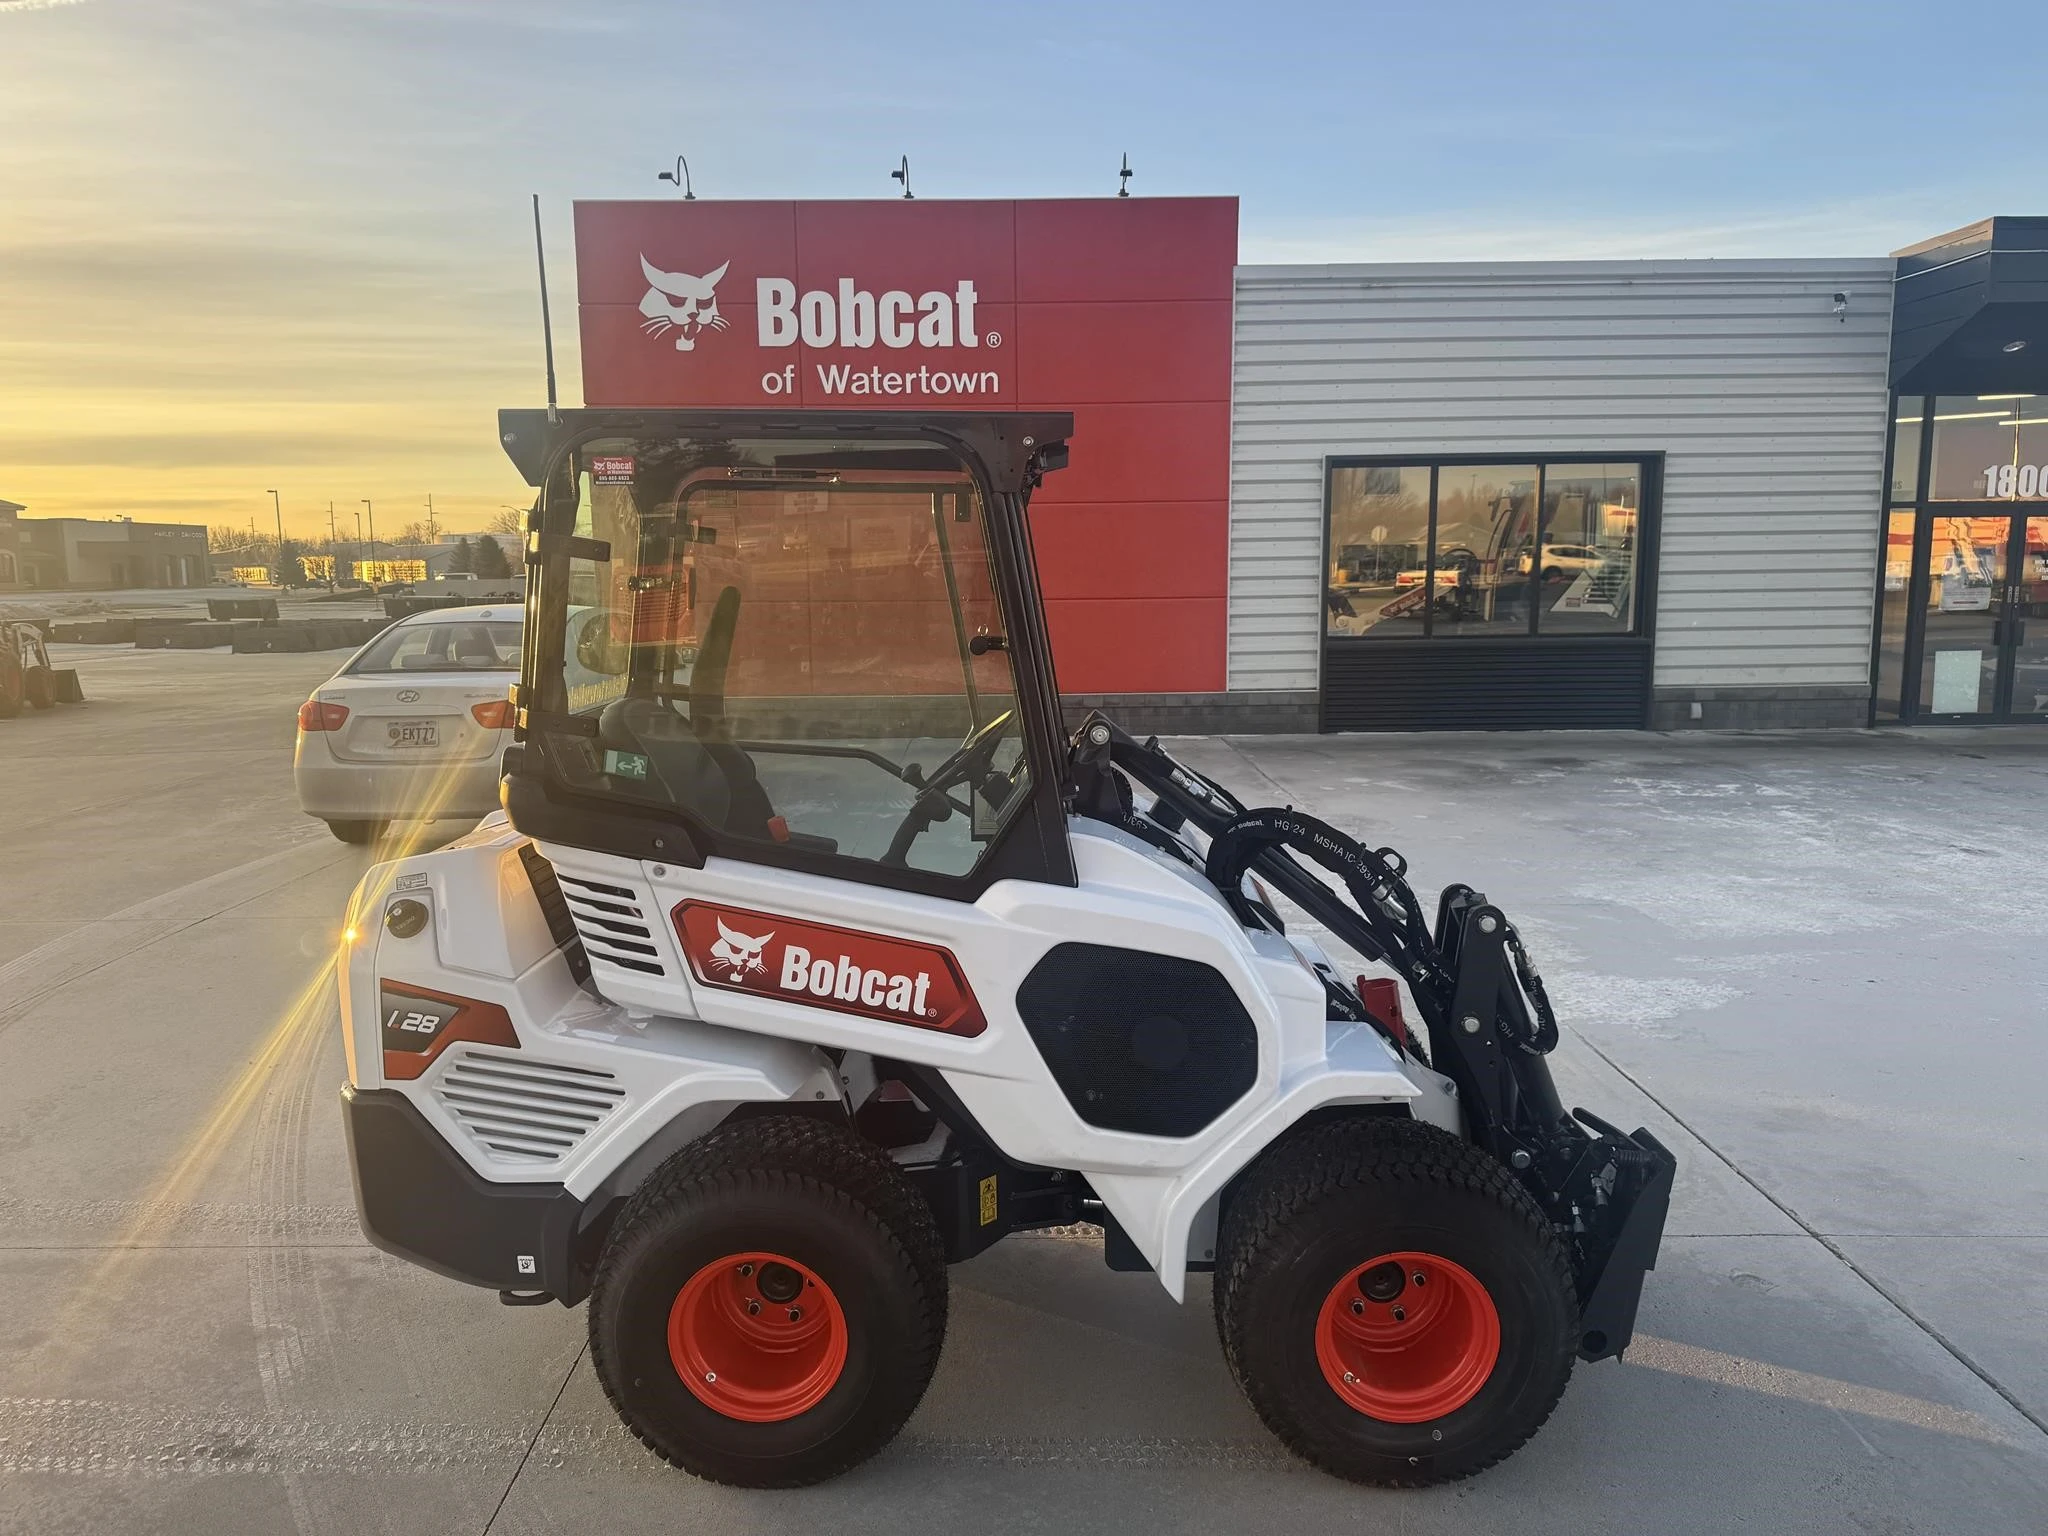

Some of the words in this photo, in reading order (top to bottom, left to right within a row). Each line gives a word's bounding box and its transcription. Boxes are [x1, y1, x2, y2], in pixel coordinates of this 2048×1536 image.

[756, 277, 979, 348] Bobcat
[761, 364, 795, 394] of
[816, 364, 999, 394] Watertown
[1313, 833, 1344, 857] MSHA
[780, 944, 931, 1016] Bobcat
